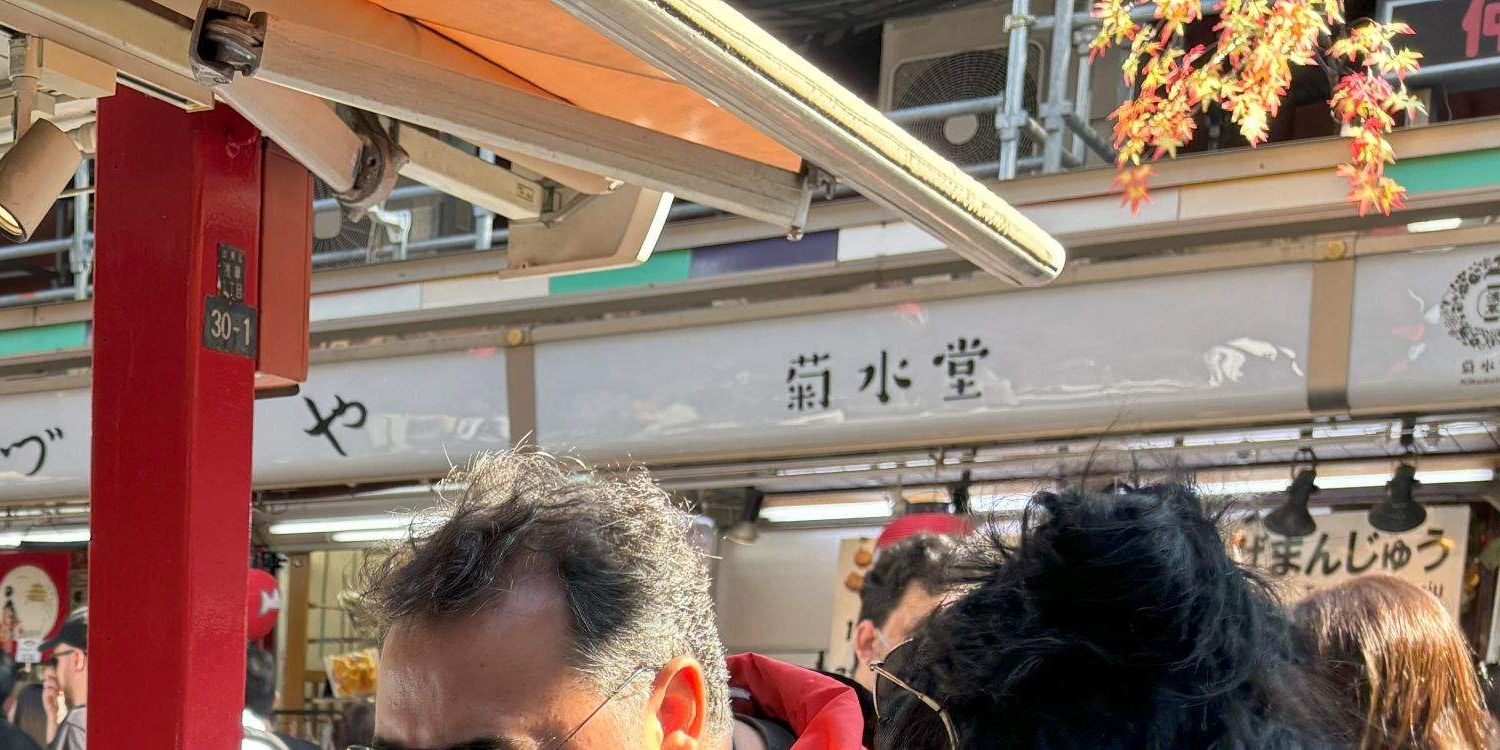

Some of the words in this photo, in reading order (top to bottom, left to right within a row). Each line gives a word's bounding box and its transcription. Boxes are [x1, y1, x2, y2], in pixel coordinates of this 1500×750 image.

[210, 308, 251, 347] 30-1
[786, 336, 990, 411] 菊水堂
